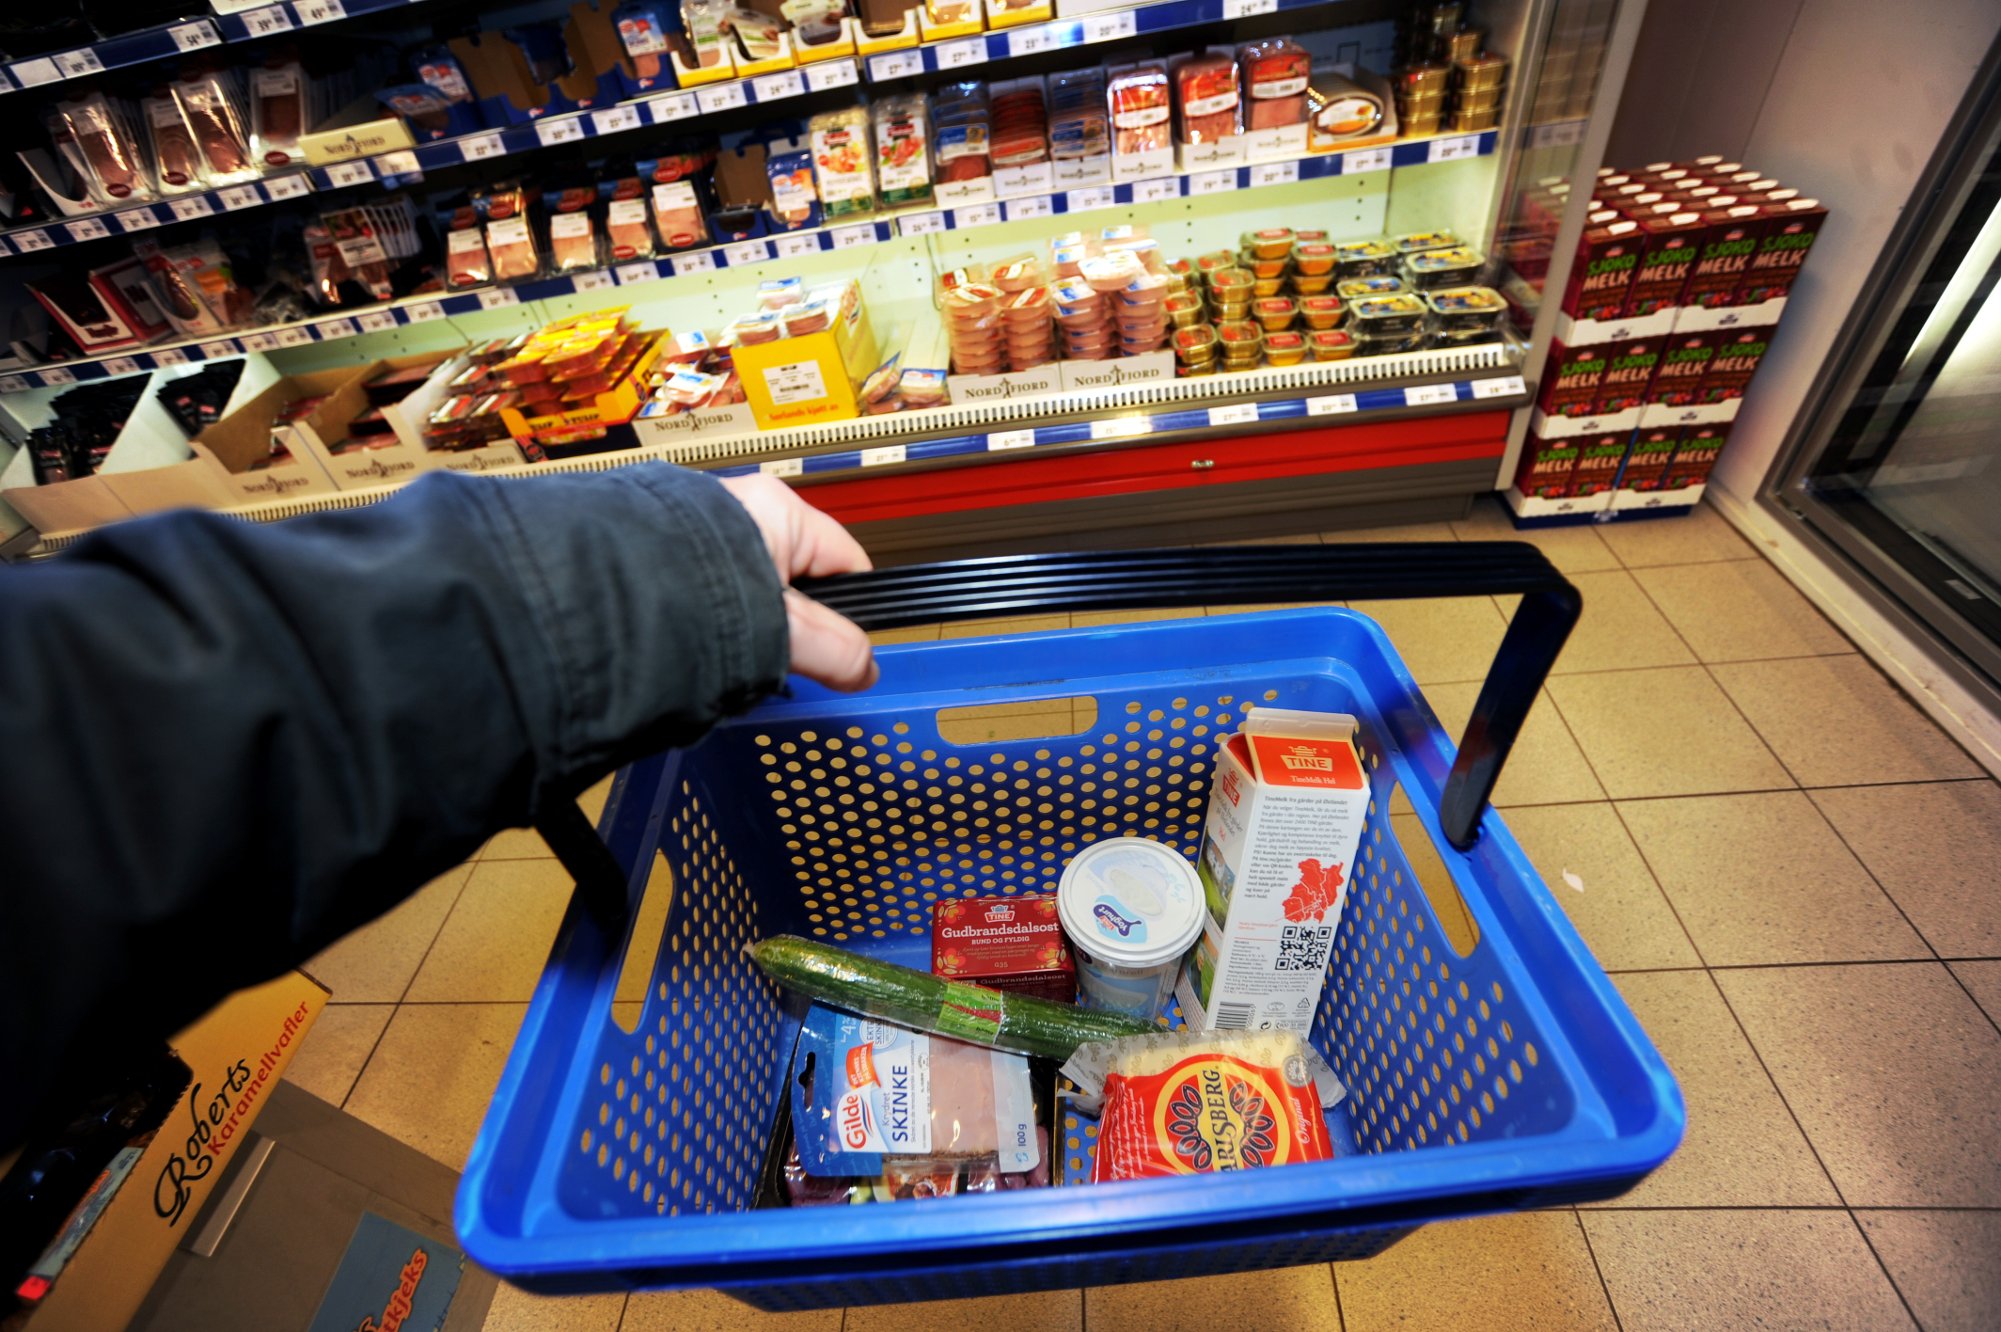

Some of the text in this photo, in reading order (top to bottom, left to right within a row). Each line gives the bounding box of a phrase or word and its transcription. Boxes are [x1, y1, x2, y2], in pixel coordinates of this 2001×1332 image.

[1697, 256, 1749, 275] MELK
[1753, 249, 1807, 268] MELK
[1583, 270, 1632, 291] MELK
[1638, 263, 1689, 283] MELK
[1660, 362, 1706, 377] MELK
[1711, 357, 1758, 372] MELK
[1556, 373, 1600, 390] MELK
[1606, 368, 1652, 383] MELK
[1287, 757, 1328, 769] TINE
[1291, 775, 1323, 785] TineMelk
[989, 912, 1011, 921] TINE
[1099, 906, 1128, 931] Yoghurt
[942, 922, 1059, 938] Gudbrandsdalsost
[980, 973, 1067, 985] Gudbrandsdalsost
[208, 1001, 309, 1156] Karamellvafler
[882, 1092, 891, 1127] Krydret
[892, 1065, 908, 1142] SKINKE
[843, 1095, 867, 1149] Gilde
[1202, 1069, 1240, 1174] ARLSBERG
[154, 1059, 252, 1228] Roberts
[1017, 1134, 1027, 1148] 100
